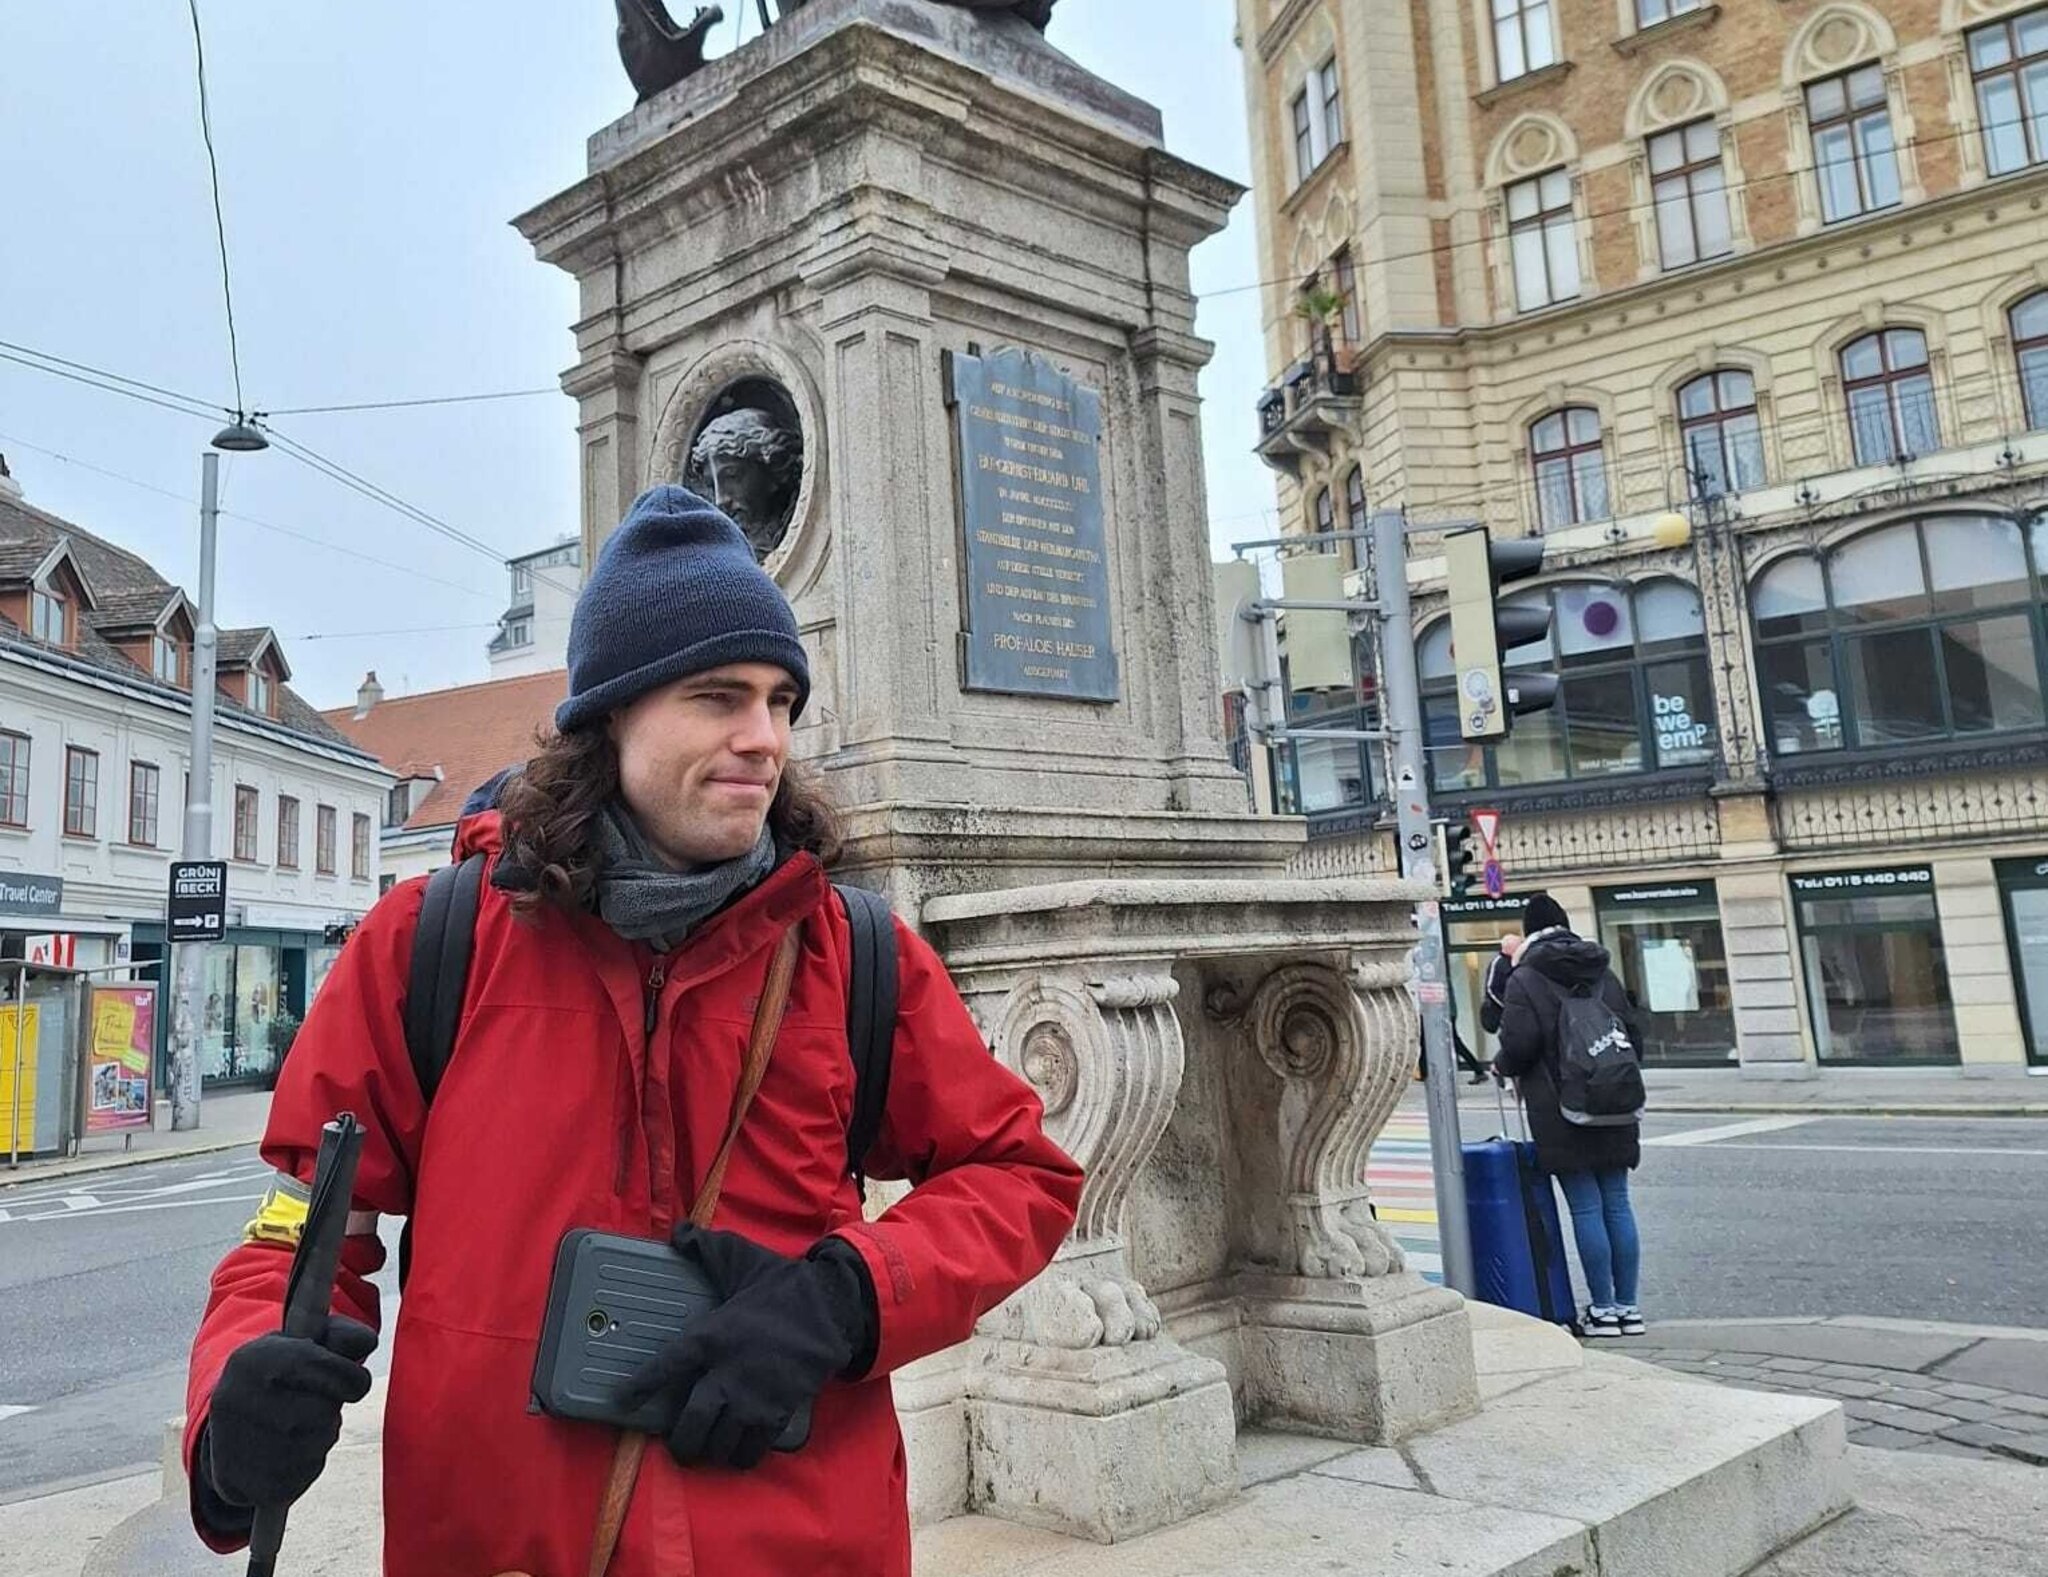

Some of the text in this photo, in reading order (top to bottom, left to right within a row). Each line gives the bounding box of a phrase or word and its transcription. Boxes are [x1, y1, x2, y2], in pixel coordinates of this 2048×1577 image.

[1653, 694, 1685, 714] be
[1656, 713, 1691, 732] we
[0, 883, 58, 904] Travel Center
[180, 883, 215, 894] BECK
